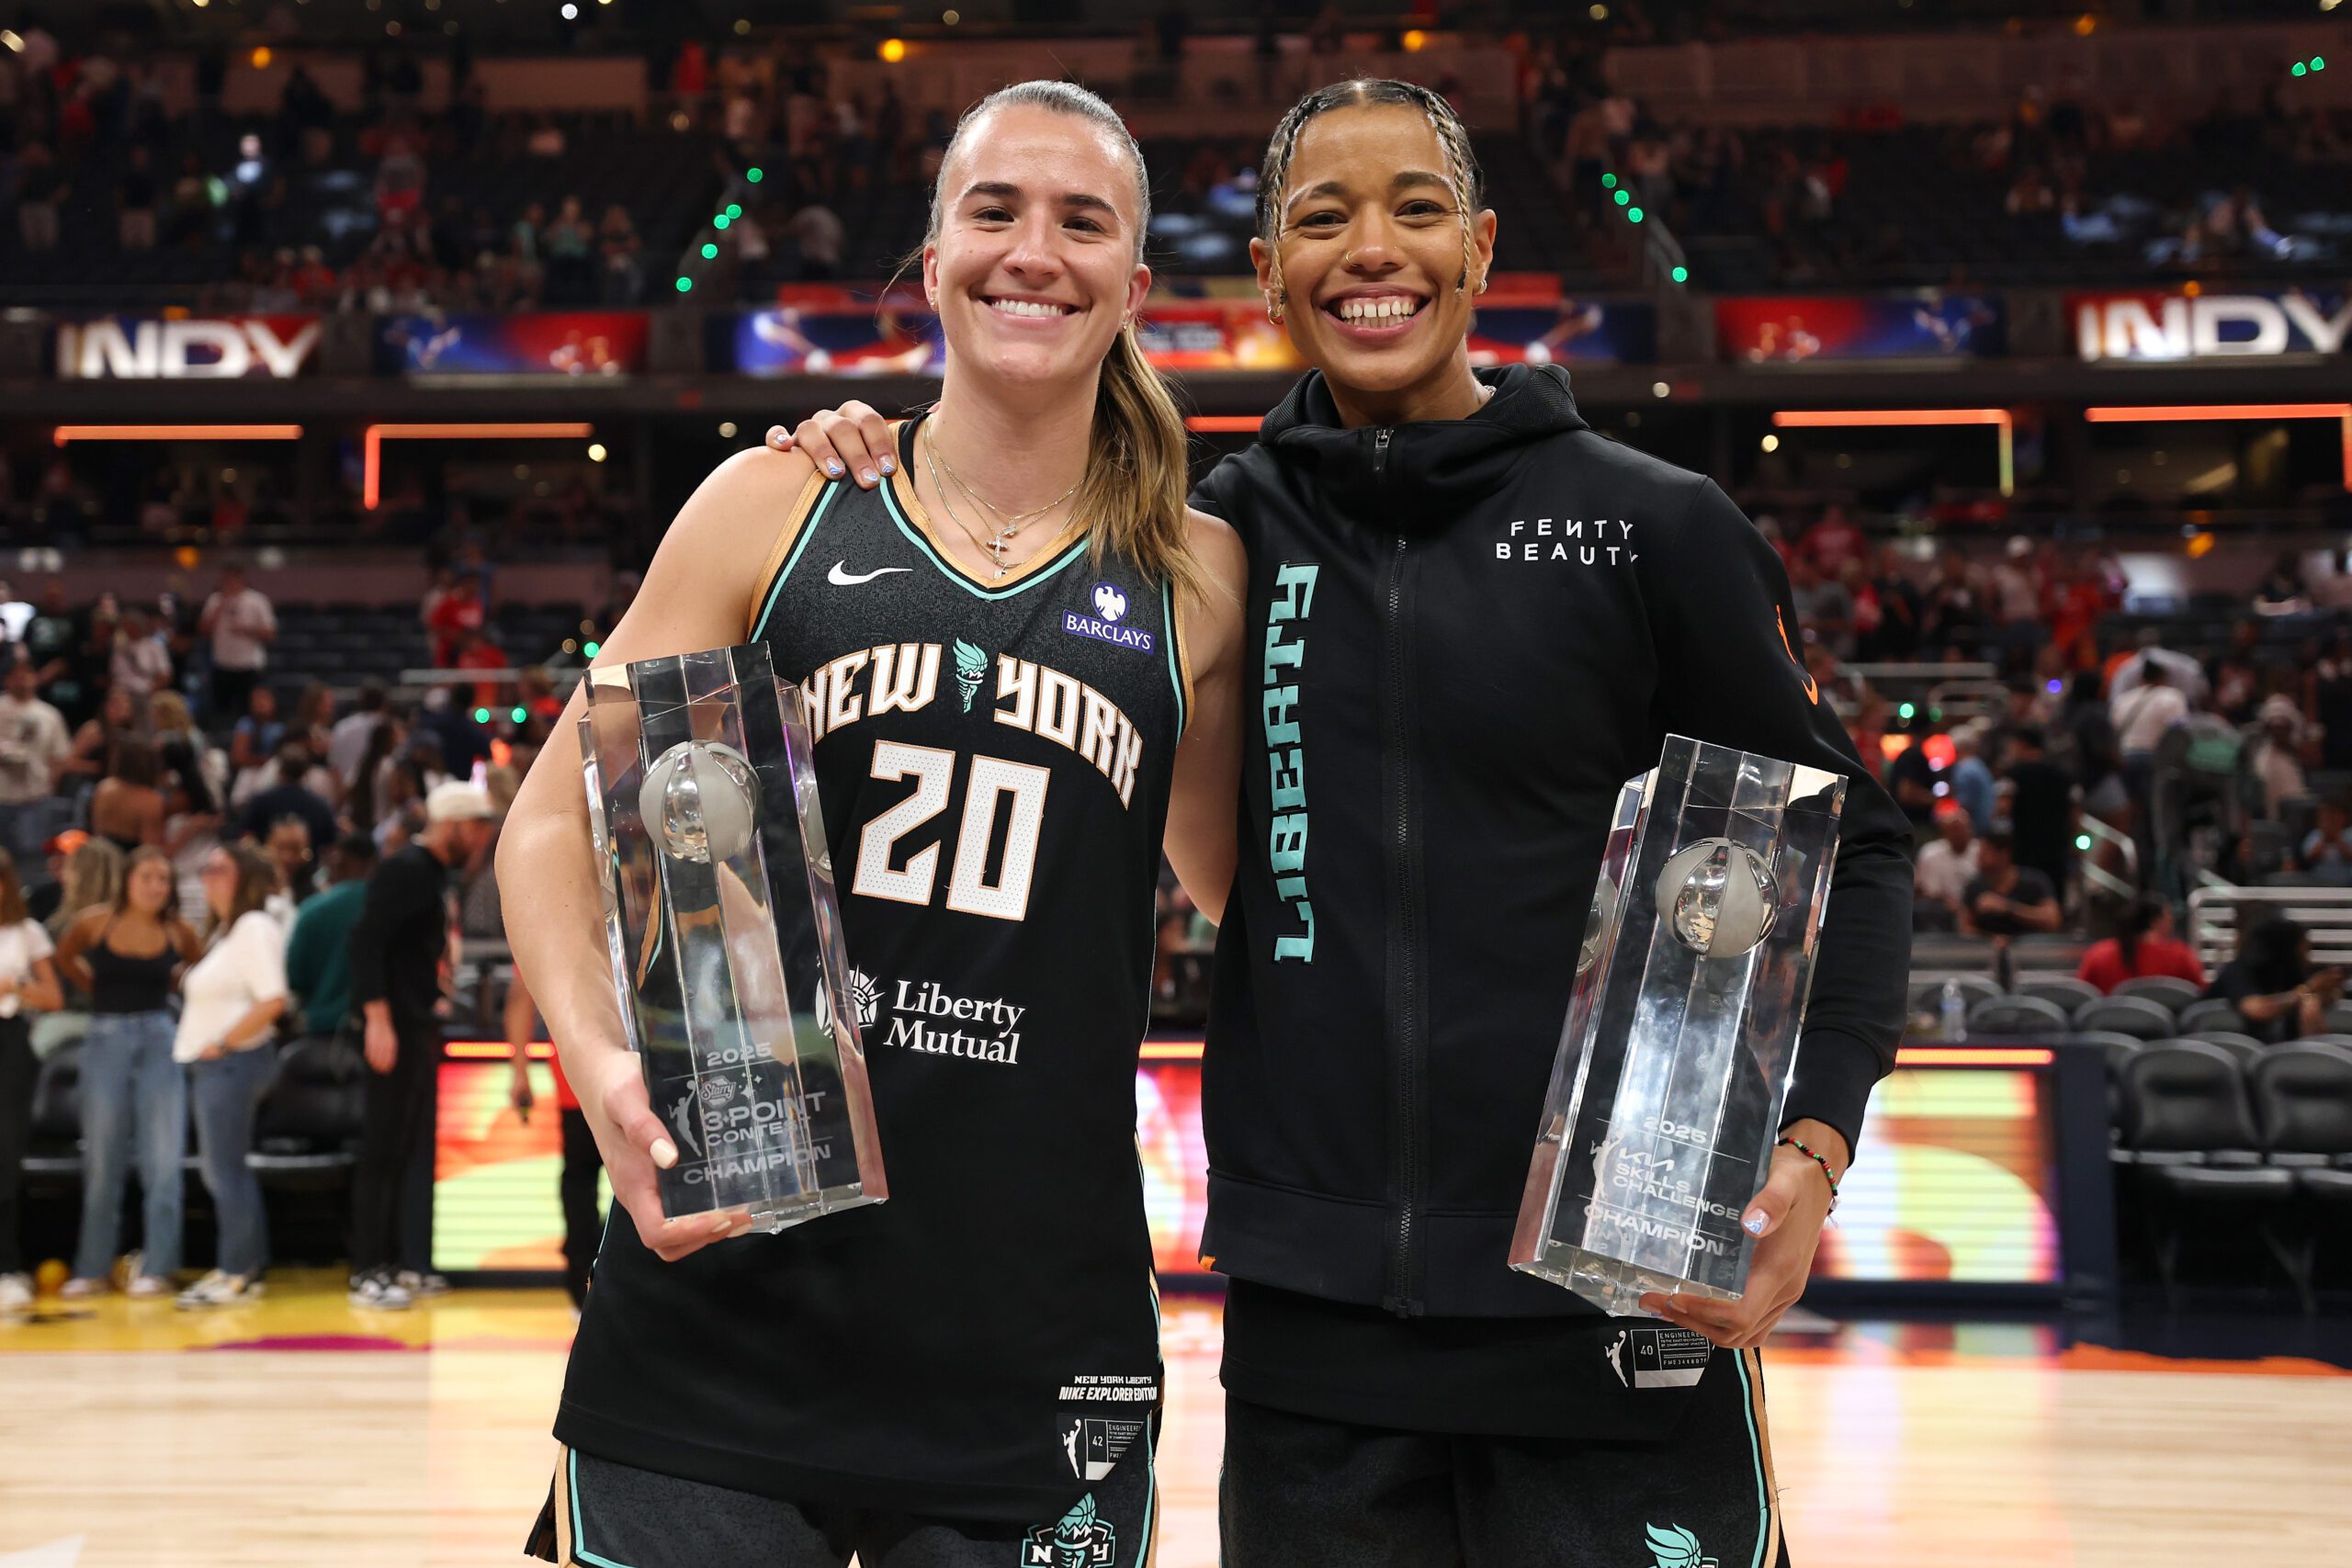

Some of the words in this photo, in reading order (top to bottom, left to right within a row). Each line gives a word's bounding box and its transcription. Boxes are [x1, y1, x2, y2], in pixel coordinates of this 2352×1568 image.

[2078, 294, 2352, 362] INDY
[57, 320, 320, 379] INDY
[1066, 614, 1151, 650] BARCLAYS
[800, 643, 943, 747] NEW
[994, 652, 1143, 811] YORK
[1263, 562, 1321, 964] LIBERTY
[852, 739, 1051, 922] 20
[892, 979, 1026, 1039] Liberty
[707, 1042, 773, 1067] 2025
[883, 1016, 1021, 1065] Mutual
[700, 1081, 735, 1101] Starry
[707, 1115, 811, 1147] CONTEST
[1644, 1116, 1708, 1145] 2025
[683, 1145, 831, 1185] CHAMPION
[1615, 1163, 1691, 1193] SKILLS
[1612, 1176, 1740, 1222] CHALLENGE
[1583, 1204, 1724, 1257] CHAMPION
[1640, 1345, 1654, 1356] 40
[1058, 1386, 1086, 1400] NIKE
[1086, 1386, 1133, 1402] EXPLORER
[1074, 1375, 1098, 1384] NEW
[1100, 1375, 1124, 1384] YORK
[1125, 1376, 1152, 1384] LIBERTY
[1092, 1435, 1103, 1447] 42
[1031, 1545, 1053, 1563] N
